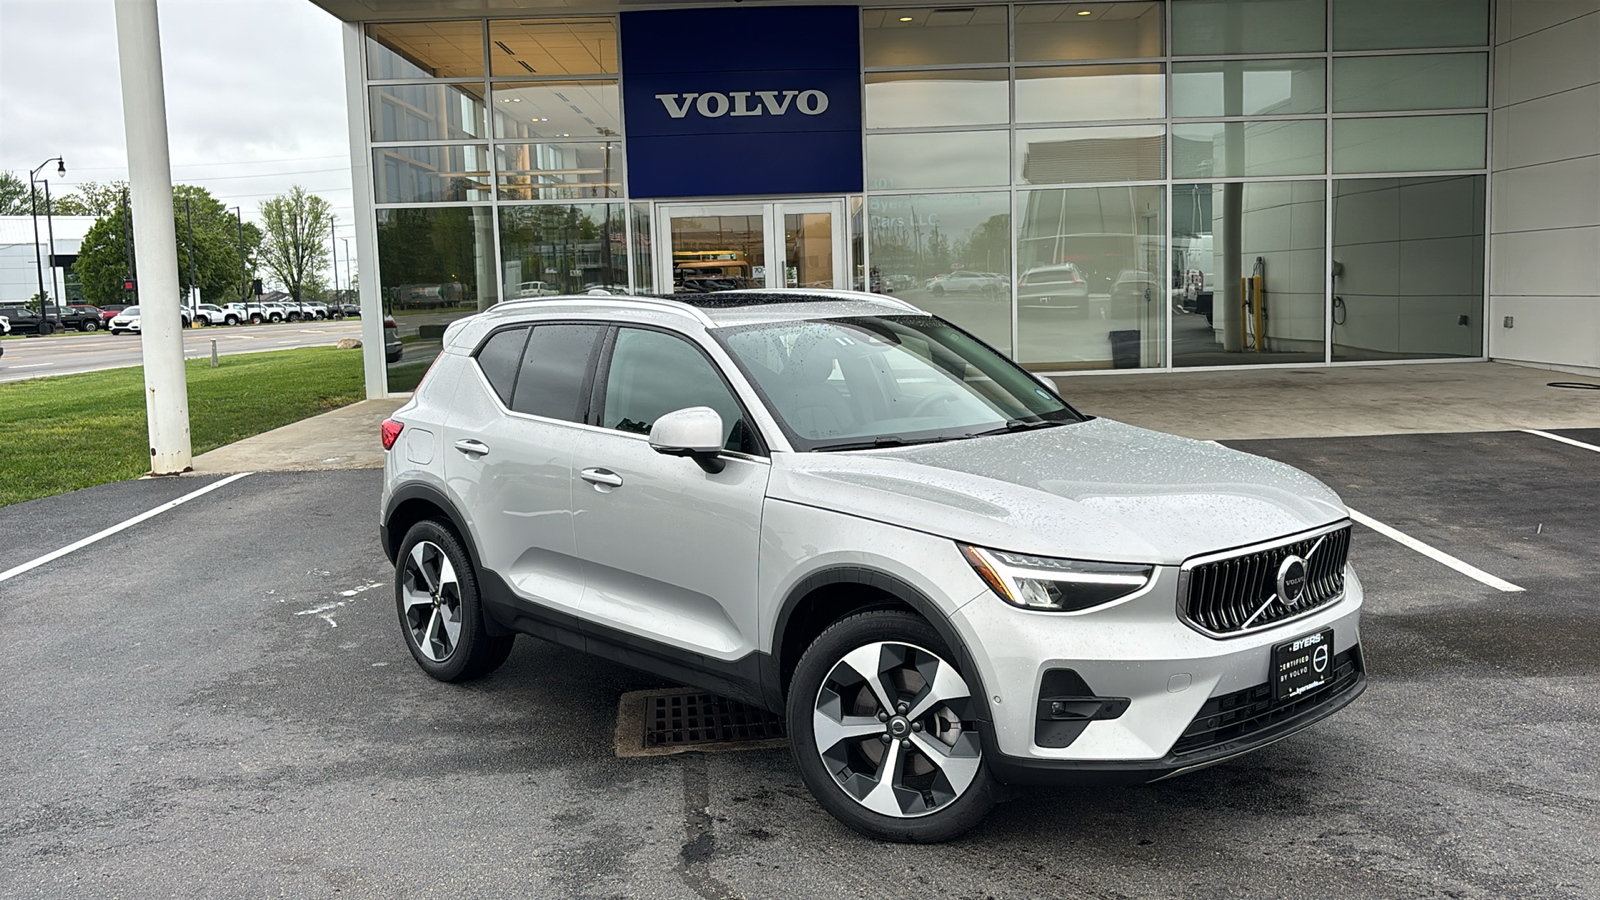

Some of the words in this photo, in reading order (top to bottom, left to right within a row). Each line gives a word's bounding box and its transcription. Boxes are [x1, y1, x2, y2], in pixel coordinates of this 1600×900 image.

[655, 89, 829, 118] VOLVO
[870, 198, 912, 213] Byers
[871, 216, 904, 228] Cars
[910, 213, 940, 226] LLC
[1293, 633, 1321, 651] BYERS
[1279, 655, 1309, 671] CERTIFIED
[1280, 674, 1288, 683] BY
[1289, 666, 1308, 678] VOLVO
